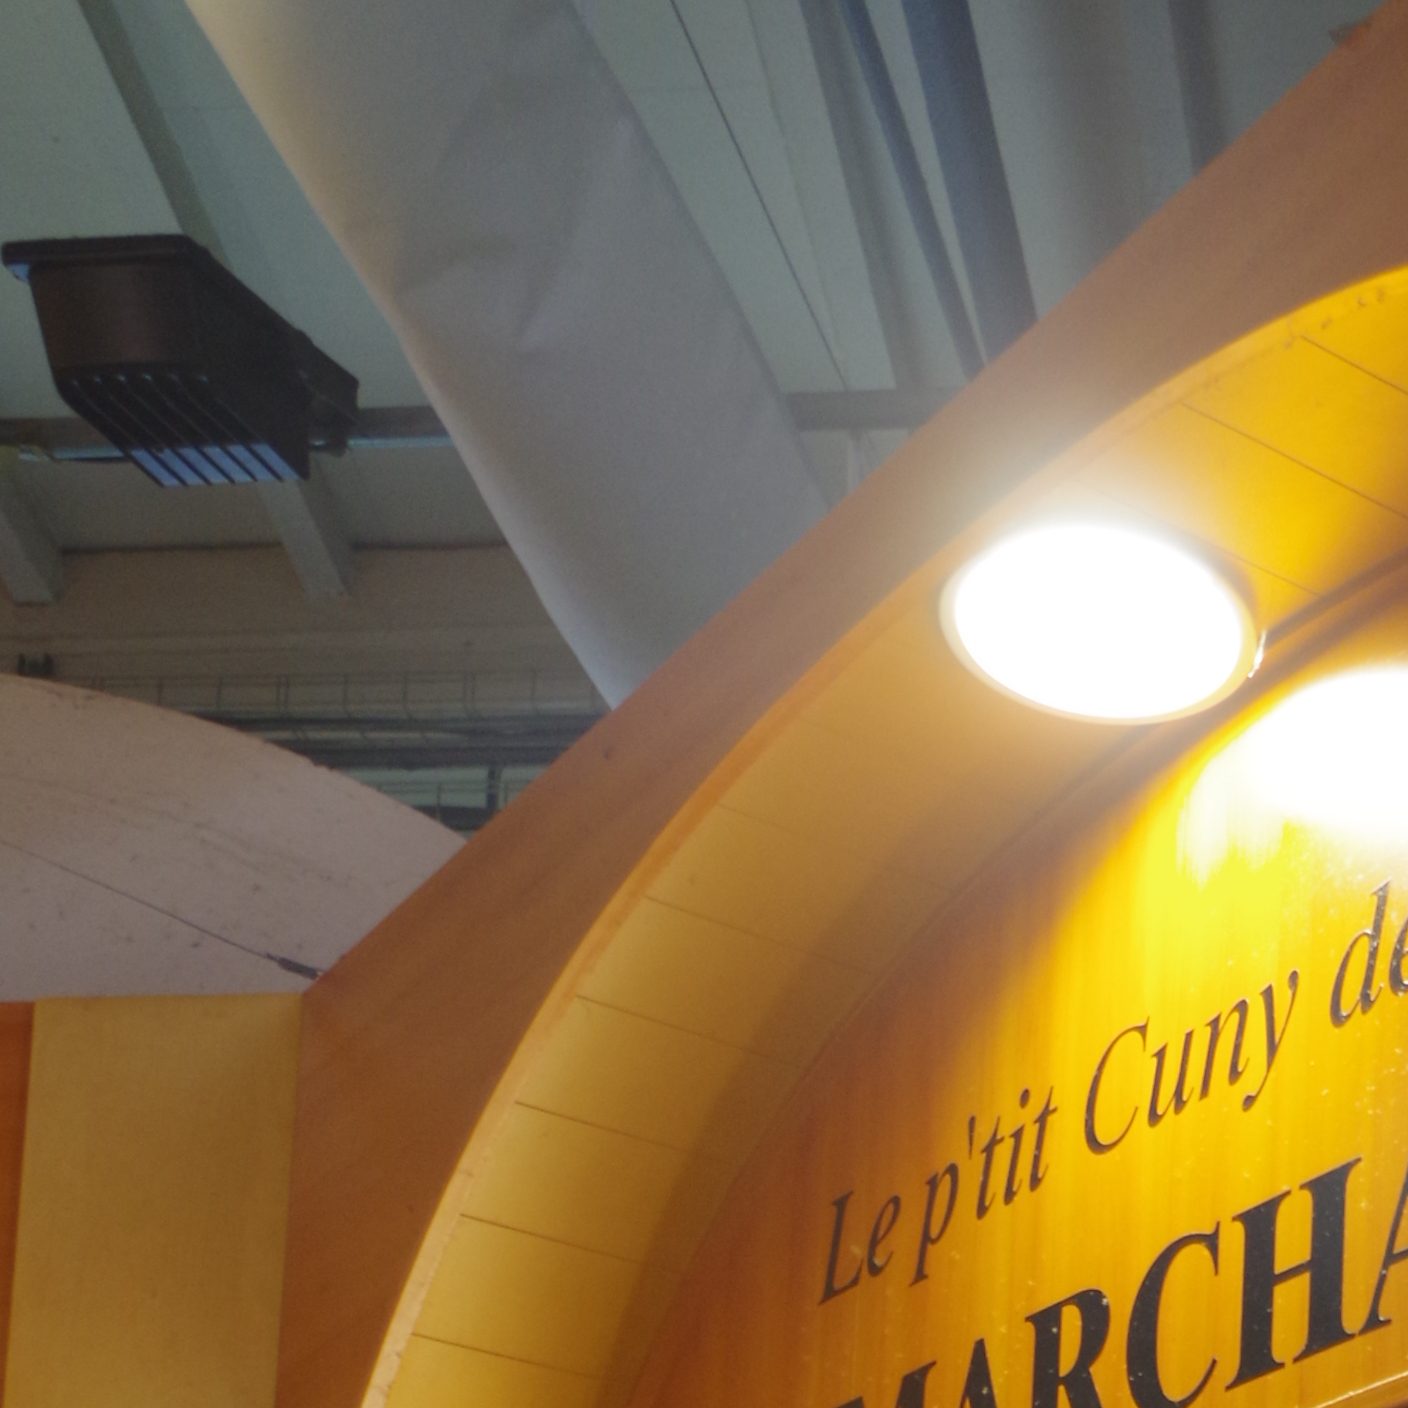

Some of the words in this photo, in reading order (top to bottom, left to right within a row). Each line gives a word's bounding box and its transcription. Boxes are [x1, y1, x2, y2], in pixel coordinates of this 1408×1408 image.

[819, 1190, 900, 1305] Le
[909, 1086, 1058, 1287] p'tit
[1084, 969, 1300, 1155] Cuny
